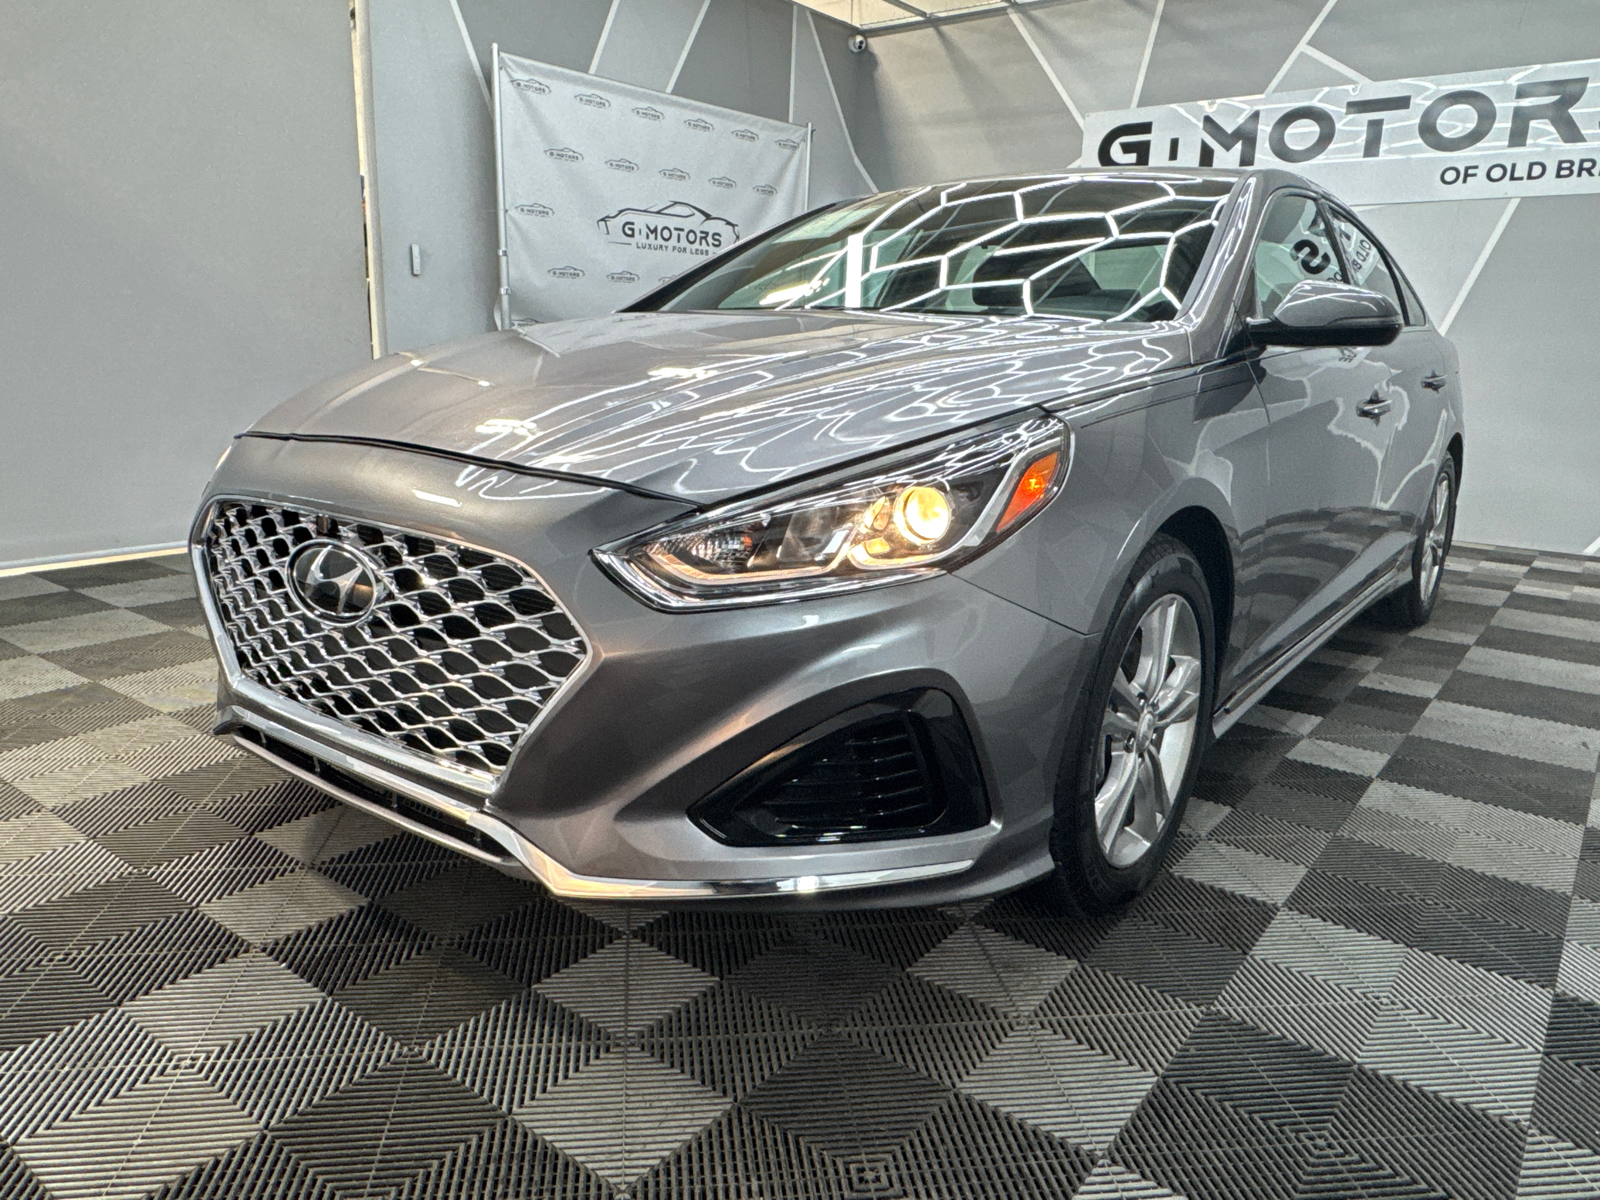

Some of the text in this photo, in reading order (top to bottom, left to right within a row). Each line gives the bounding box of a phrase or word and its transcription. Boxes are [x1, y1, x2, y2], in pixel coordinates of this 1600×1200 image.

[1199, 77, 1600, 167] MOTOR
[1440, 158, 1600, 185] OF OLD BR
[636, 242, 709, 256] LUXURY FOR LESS
